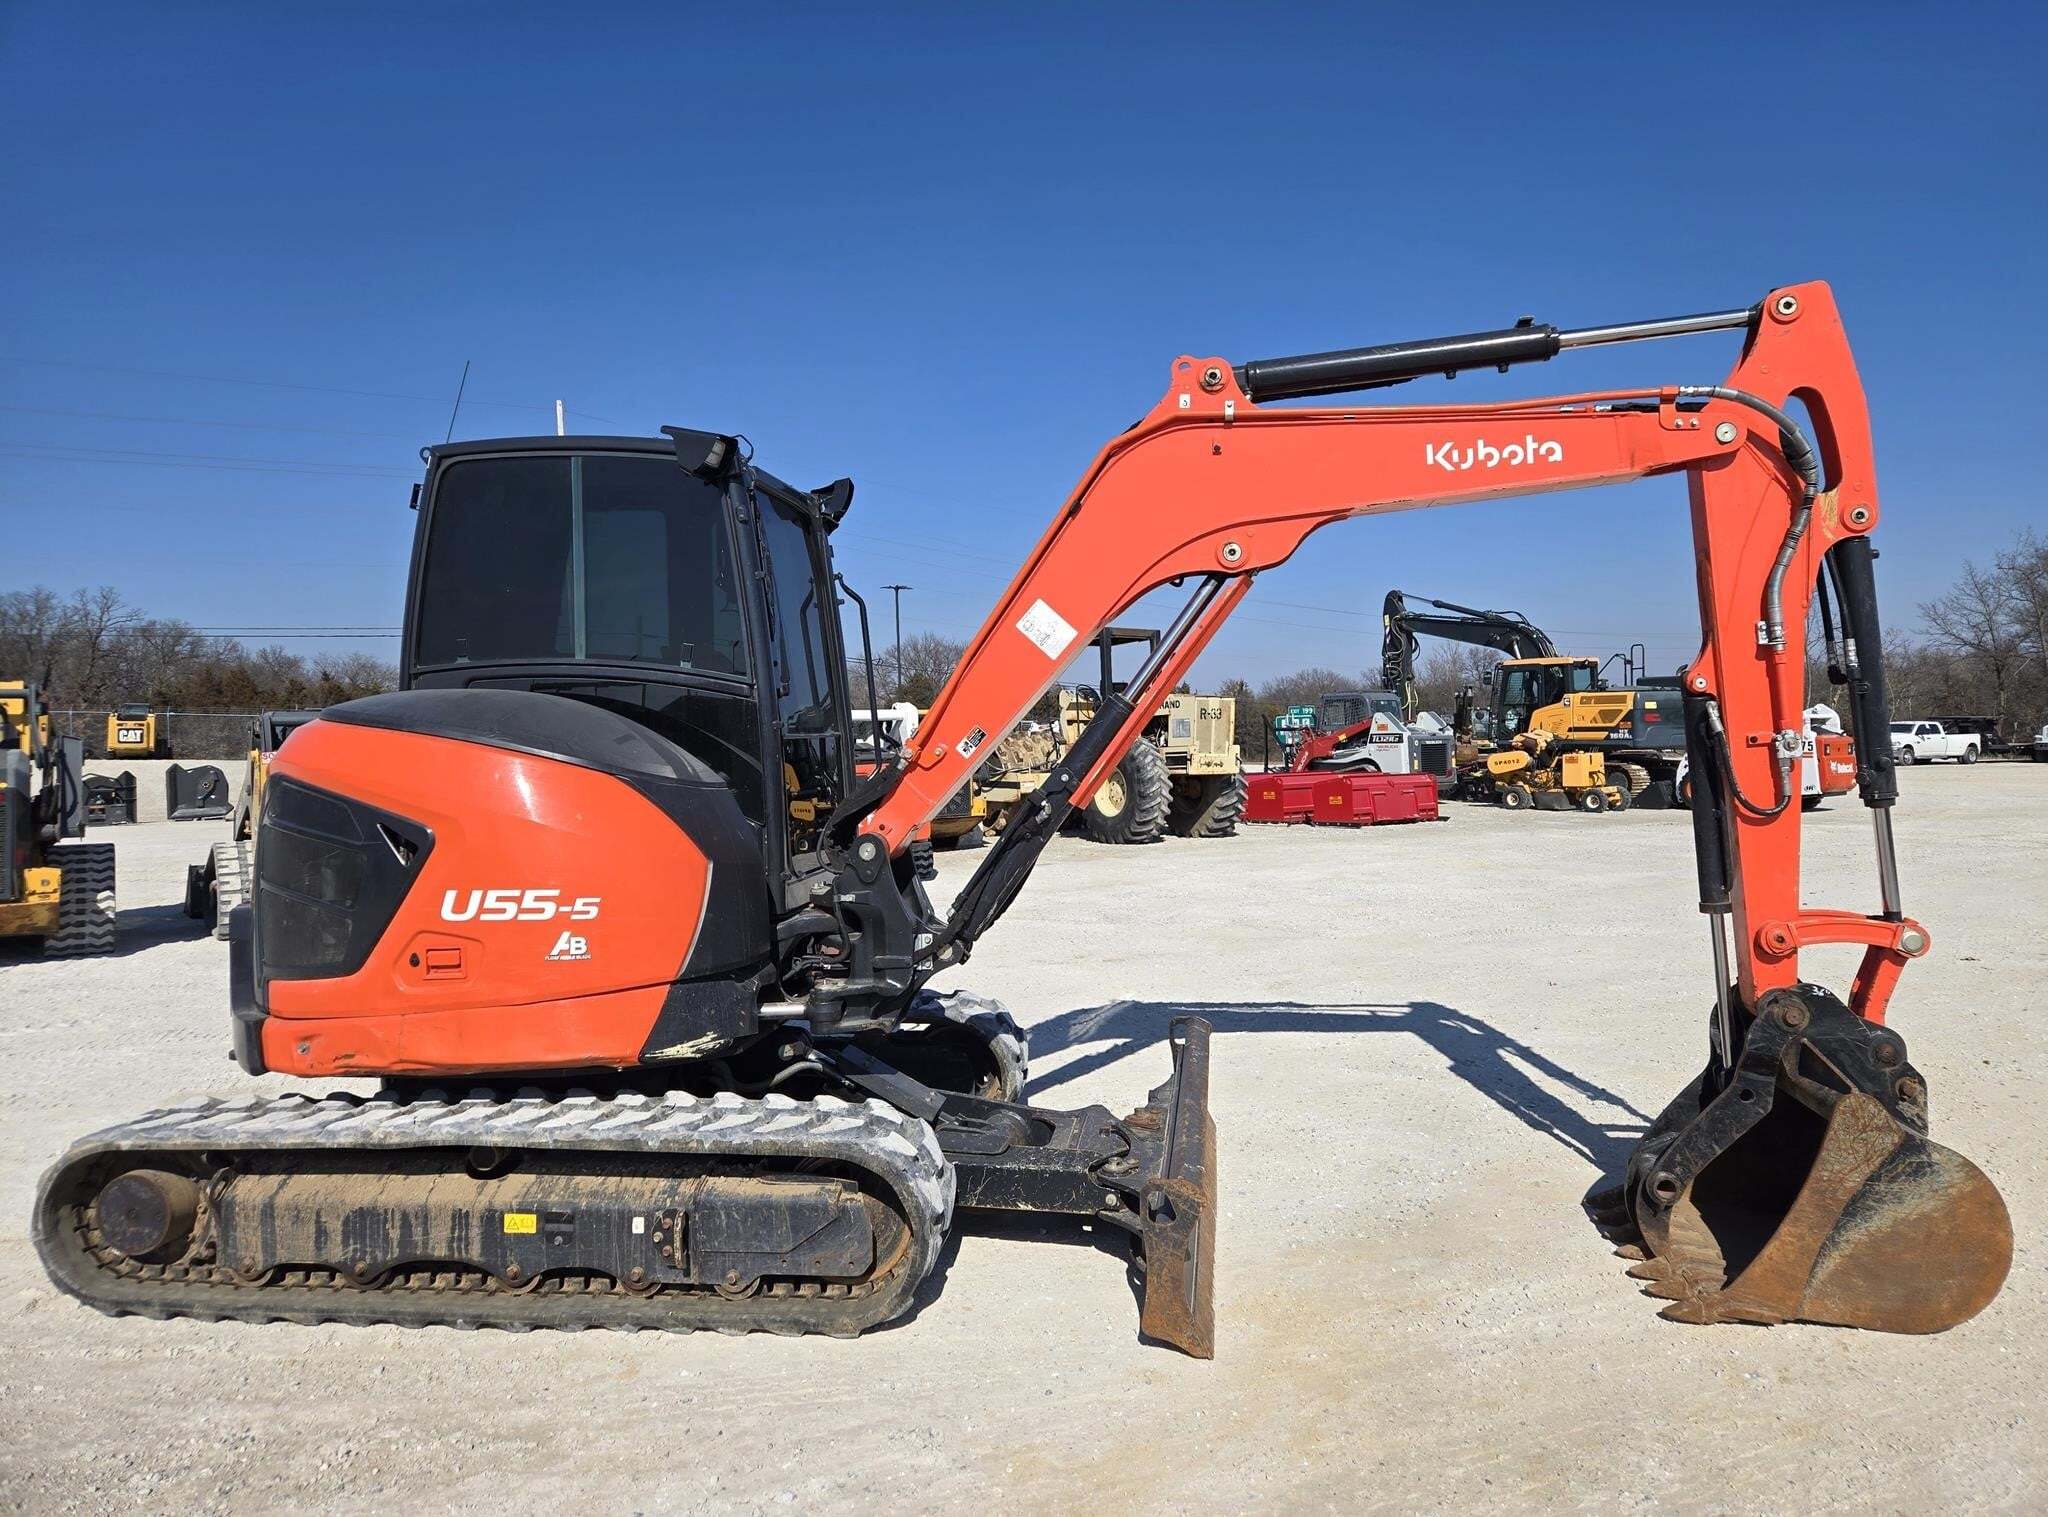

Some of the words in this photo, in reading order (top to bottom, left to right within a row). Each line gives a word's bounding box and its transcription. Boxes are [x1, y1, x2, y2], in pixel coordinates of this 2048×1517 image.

[1426, 434, 1563, 471] Kubota
[119, 729, 143, 742] CAT
[440, 889, 601, 922] U55-5
[549, 930, 588, 956] AB
